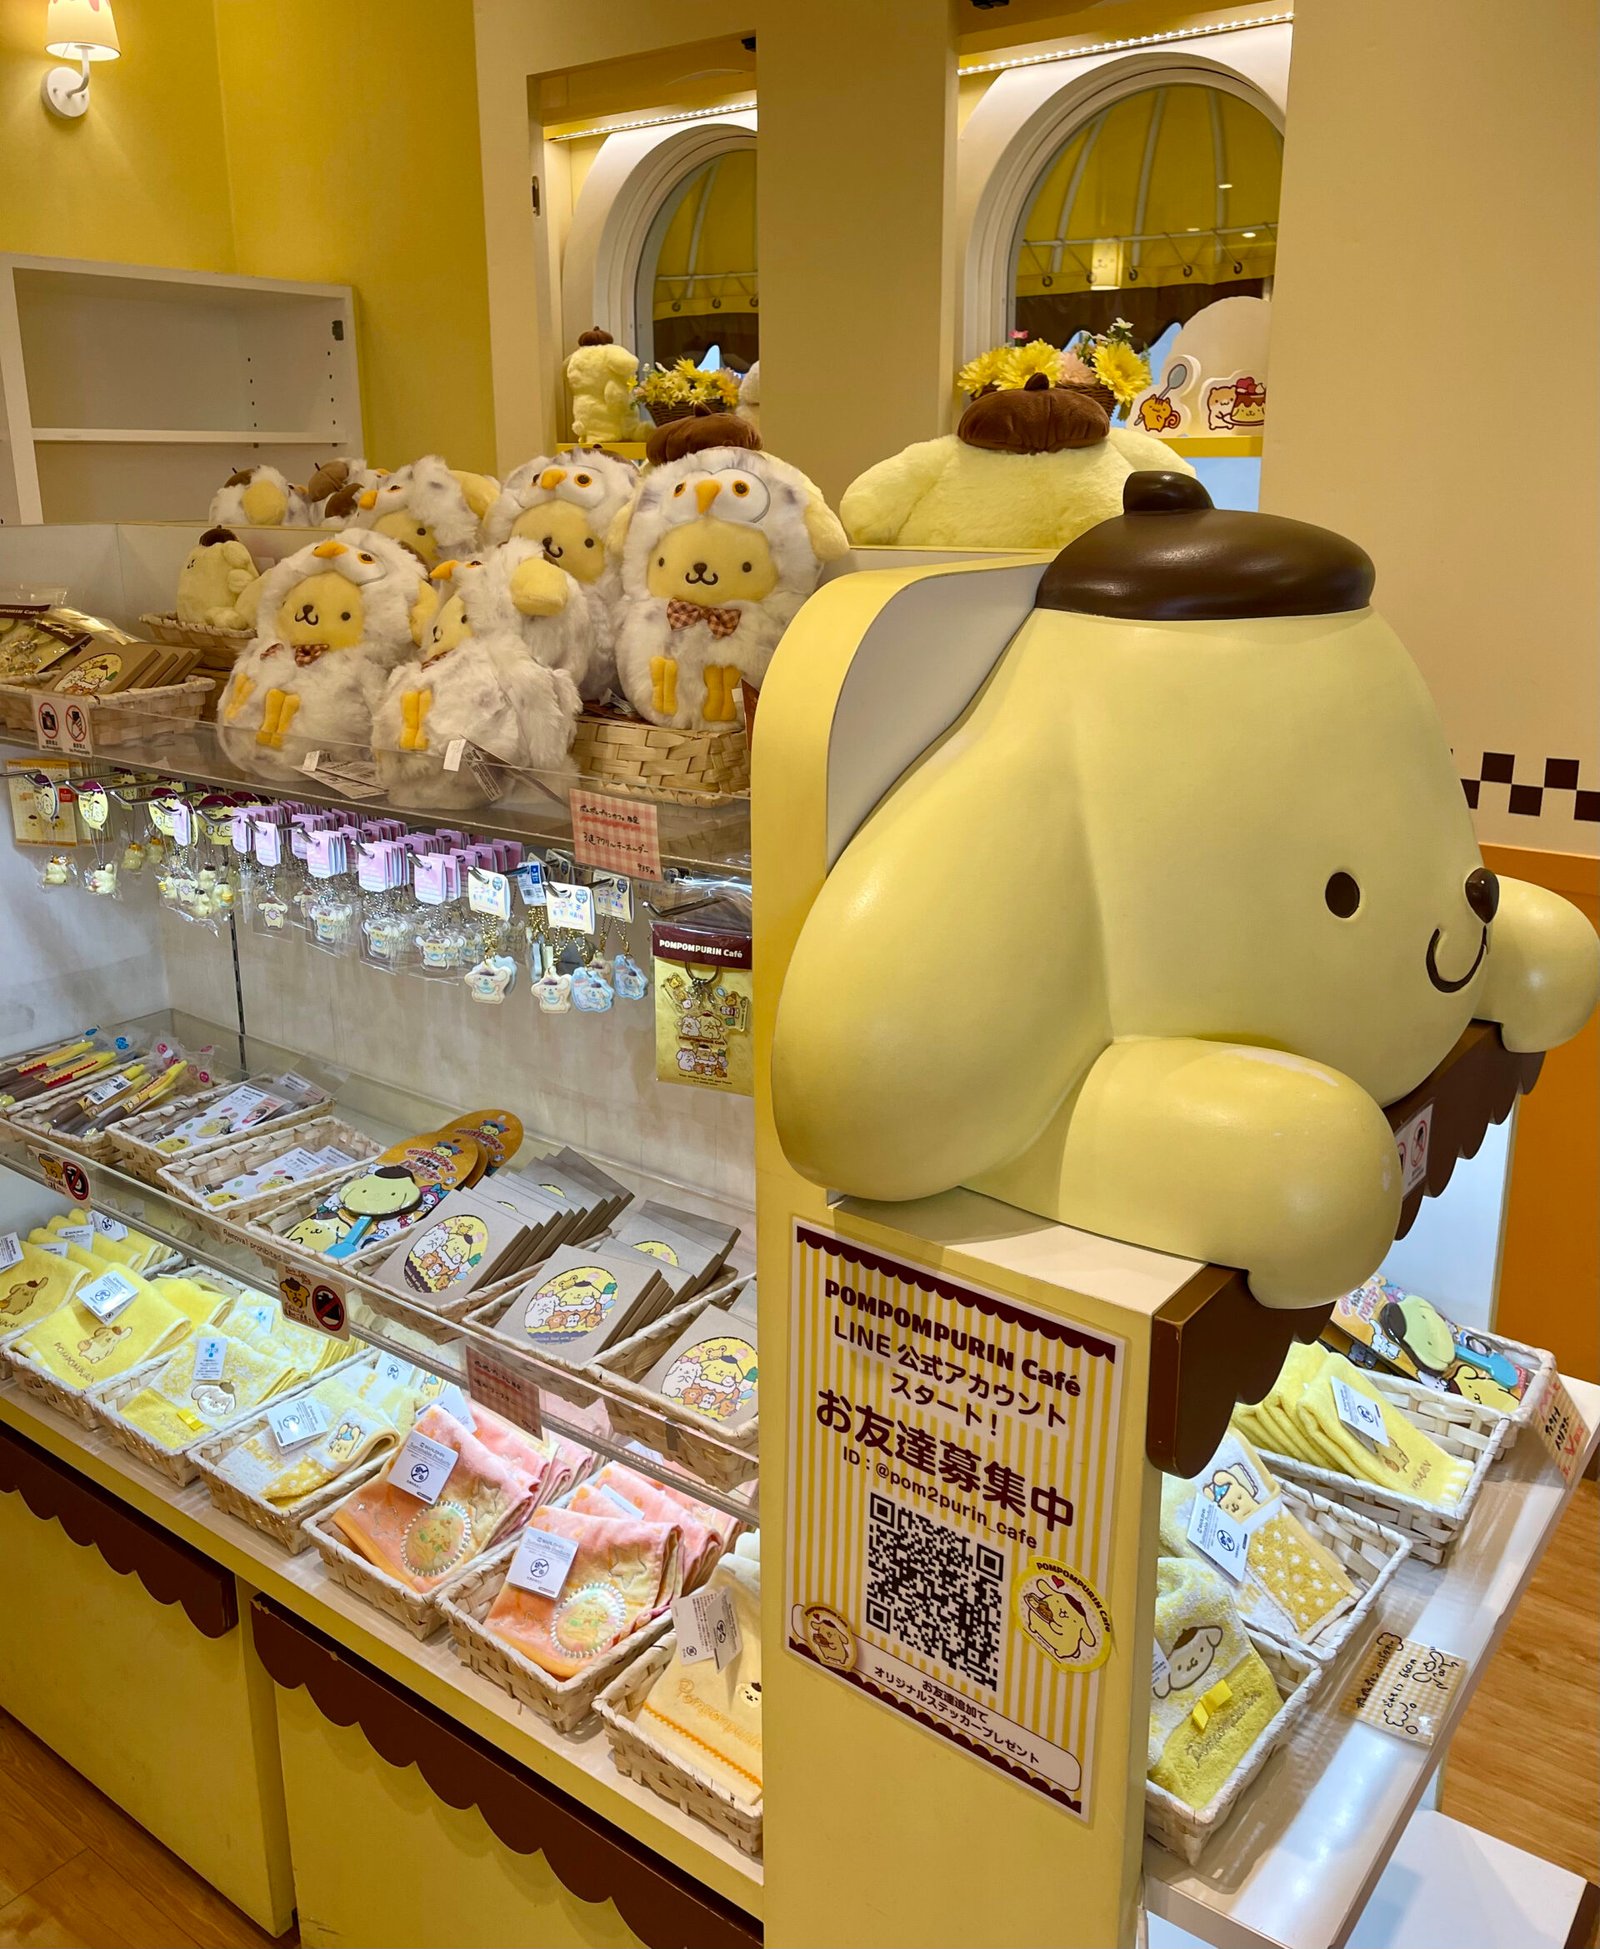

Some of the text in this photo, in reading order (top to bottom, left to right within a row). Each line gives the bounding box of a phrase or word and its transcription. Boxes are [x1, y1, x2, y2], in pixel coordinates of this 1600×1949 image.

[659, 939, 743, 958] POMPOMPURIN Café
[825, 1278, 1081, 1397] POMPOMPURIN Café
[834, 1315, 1066, 1428] LINE 公式アカウント
[891, 1373, 998, 1437] スタート！
[816, 1389, 1074, 1531] お友達募集中
[1036, 1562, 1103, 1609] POMPOMPURIN
